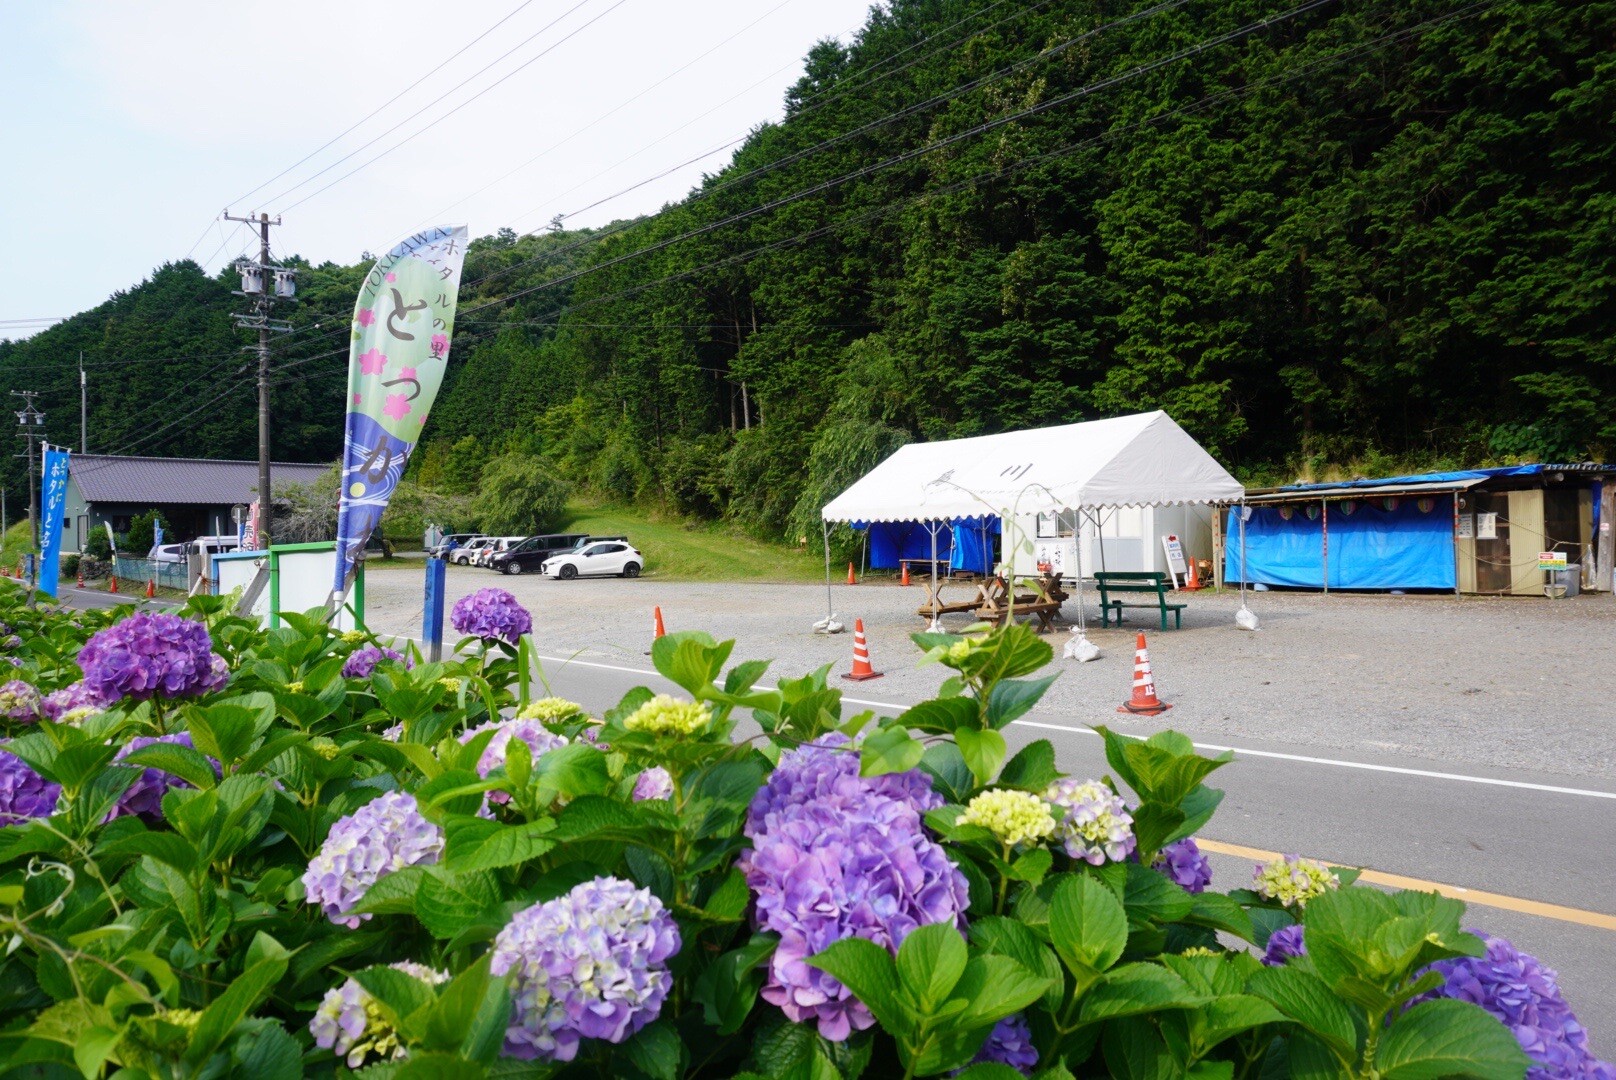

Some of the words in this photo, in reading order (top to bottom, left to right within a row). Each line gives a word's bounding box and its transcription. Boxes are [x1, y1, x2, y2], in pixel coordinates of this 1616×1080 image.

[364, 227, 447, 297] TOKKAWA
[428, 239, 459, 360] ホタルの里
